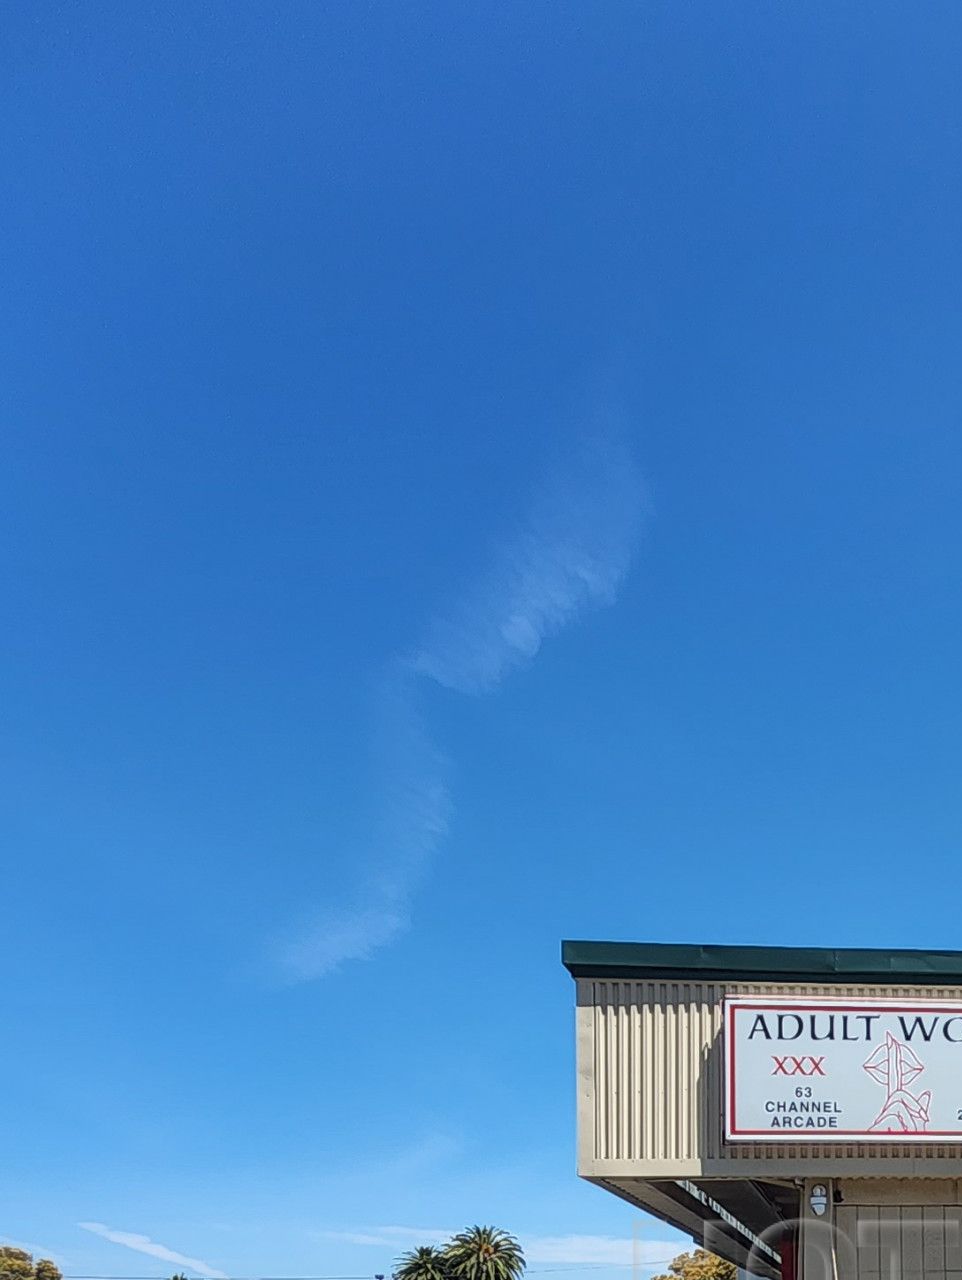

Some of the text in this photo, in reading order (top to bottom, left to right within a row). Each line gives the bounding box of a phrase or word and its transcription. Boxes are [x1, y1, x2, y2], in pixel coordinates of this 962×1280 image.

[747, 1013, 881, 1041] ADULT
[771, 1056, 827, 1076] XXX
[794, 1086, 812, 1098] 63
[764, 1100, 842, 1114] CHANNEL
[770, 1116, 838, 1129] ARCADE
